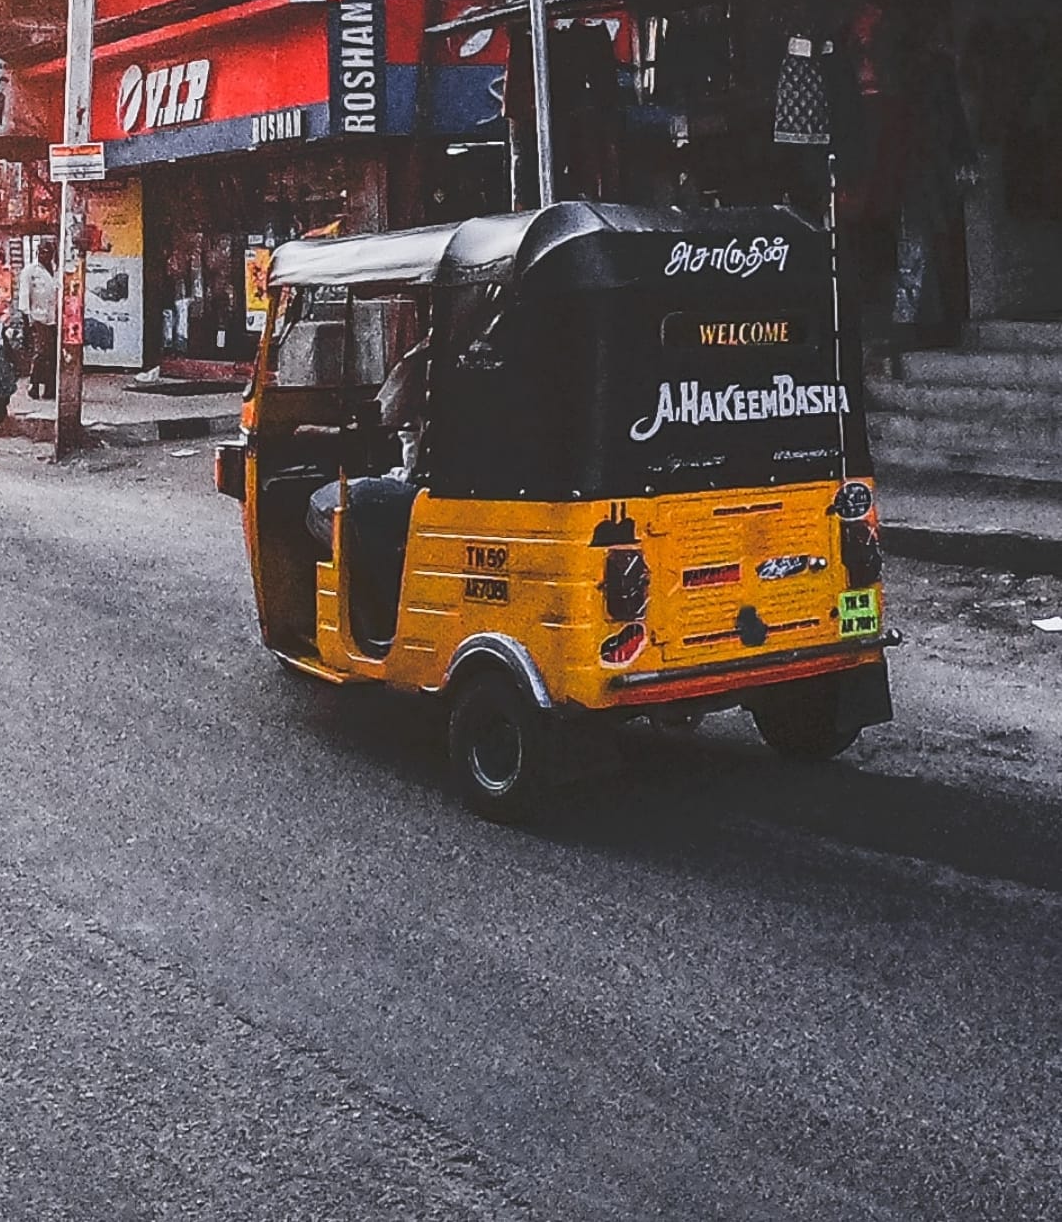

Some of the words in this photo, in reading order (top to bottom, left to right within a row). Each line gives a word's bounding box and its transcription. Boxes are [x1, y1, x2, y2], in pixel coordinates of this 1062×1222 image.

[340, 1, 376, 133] ROSHAN
[251, 108, 302, 145] ROSHAN
[699, 321, 789, 346] WELCOME
